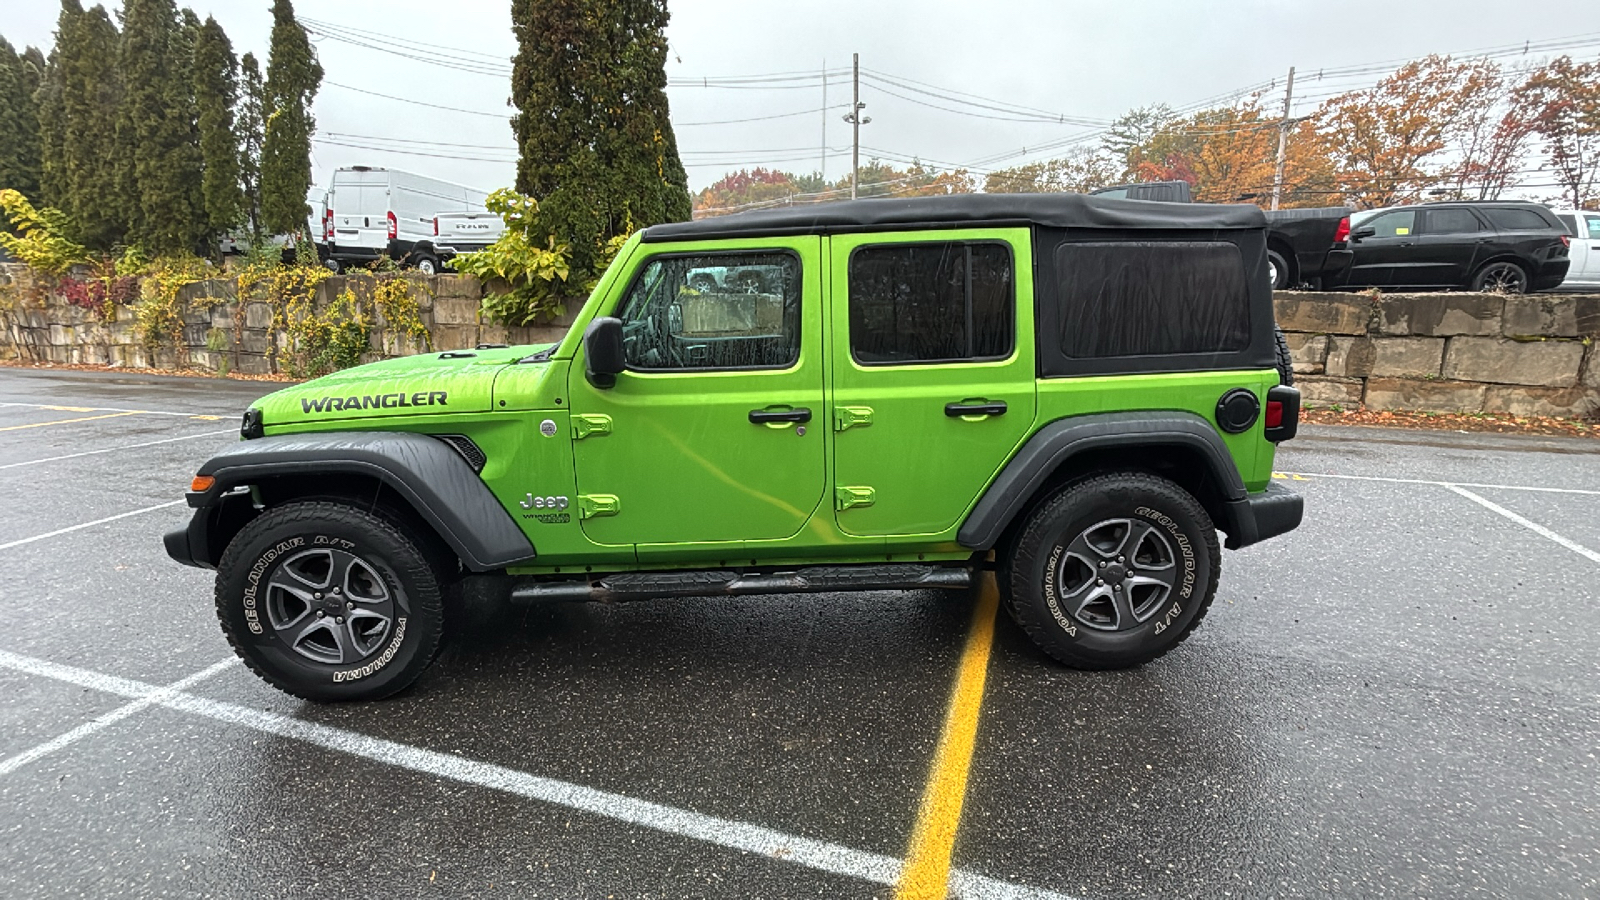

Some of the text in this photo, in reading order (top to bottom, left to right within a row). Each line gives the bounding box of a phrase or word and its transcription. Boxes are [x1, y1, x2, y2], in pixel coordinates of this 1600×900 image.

[301, 391, 448, 413] WRANGLER
[519, 492, 569, 512] Jeep
[243, 535, 355, 634] GEOLANDAR A/T
[1045, 545, 1077, 637] YOKOHAMA
[1135, 507, 1195, 635] GEOLANDAR A/T
[333, 617, 407, 682] YOKOHAMA
